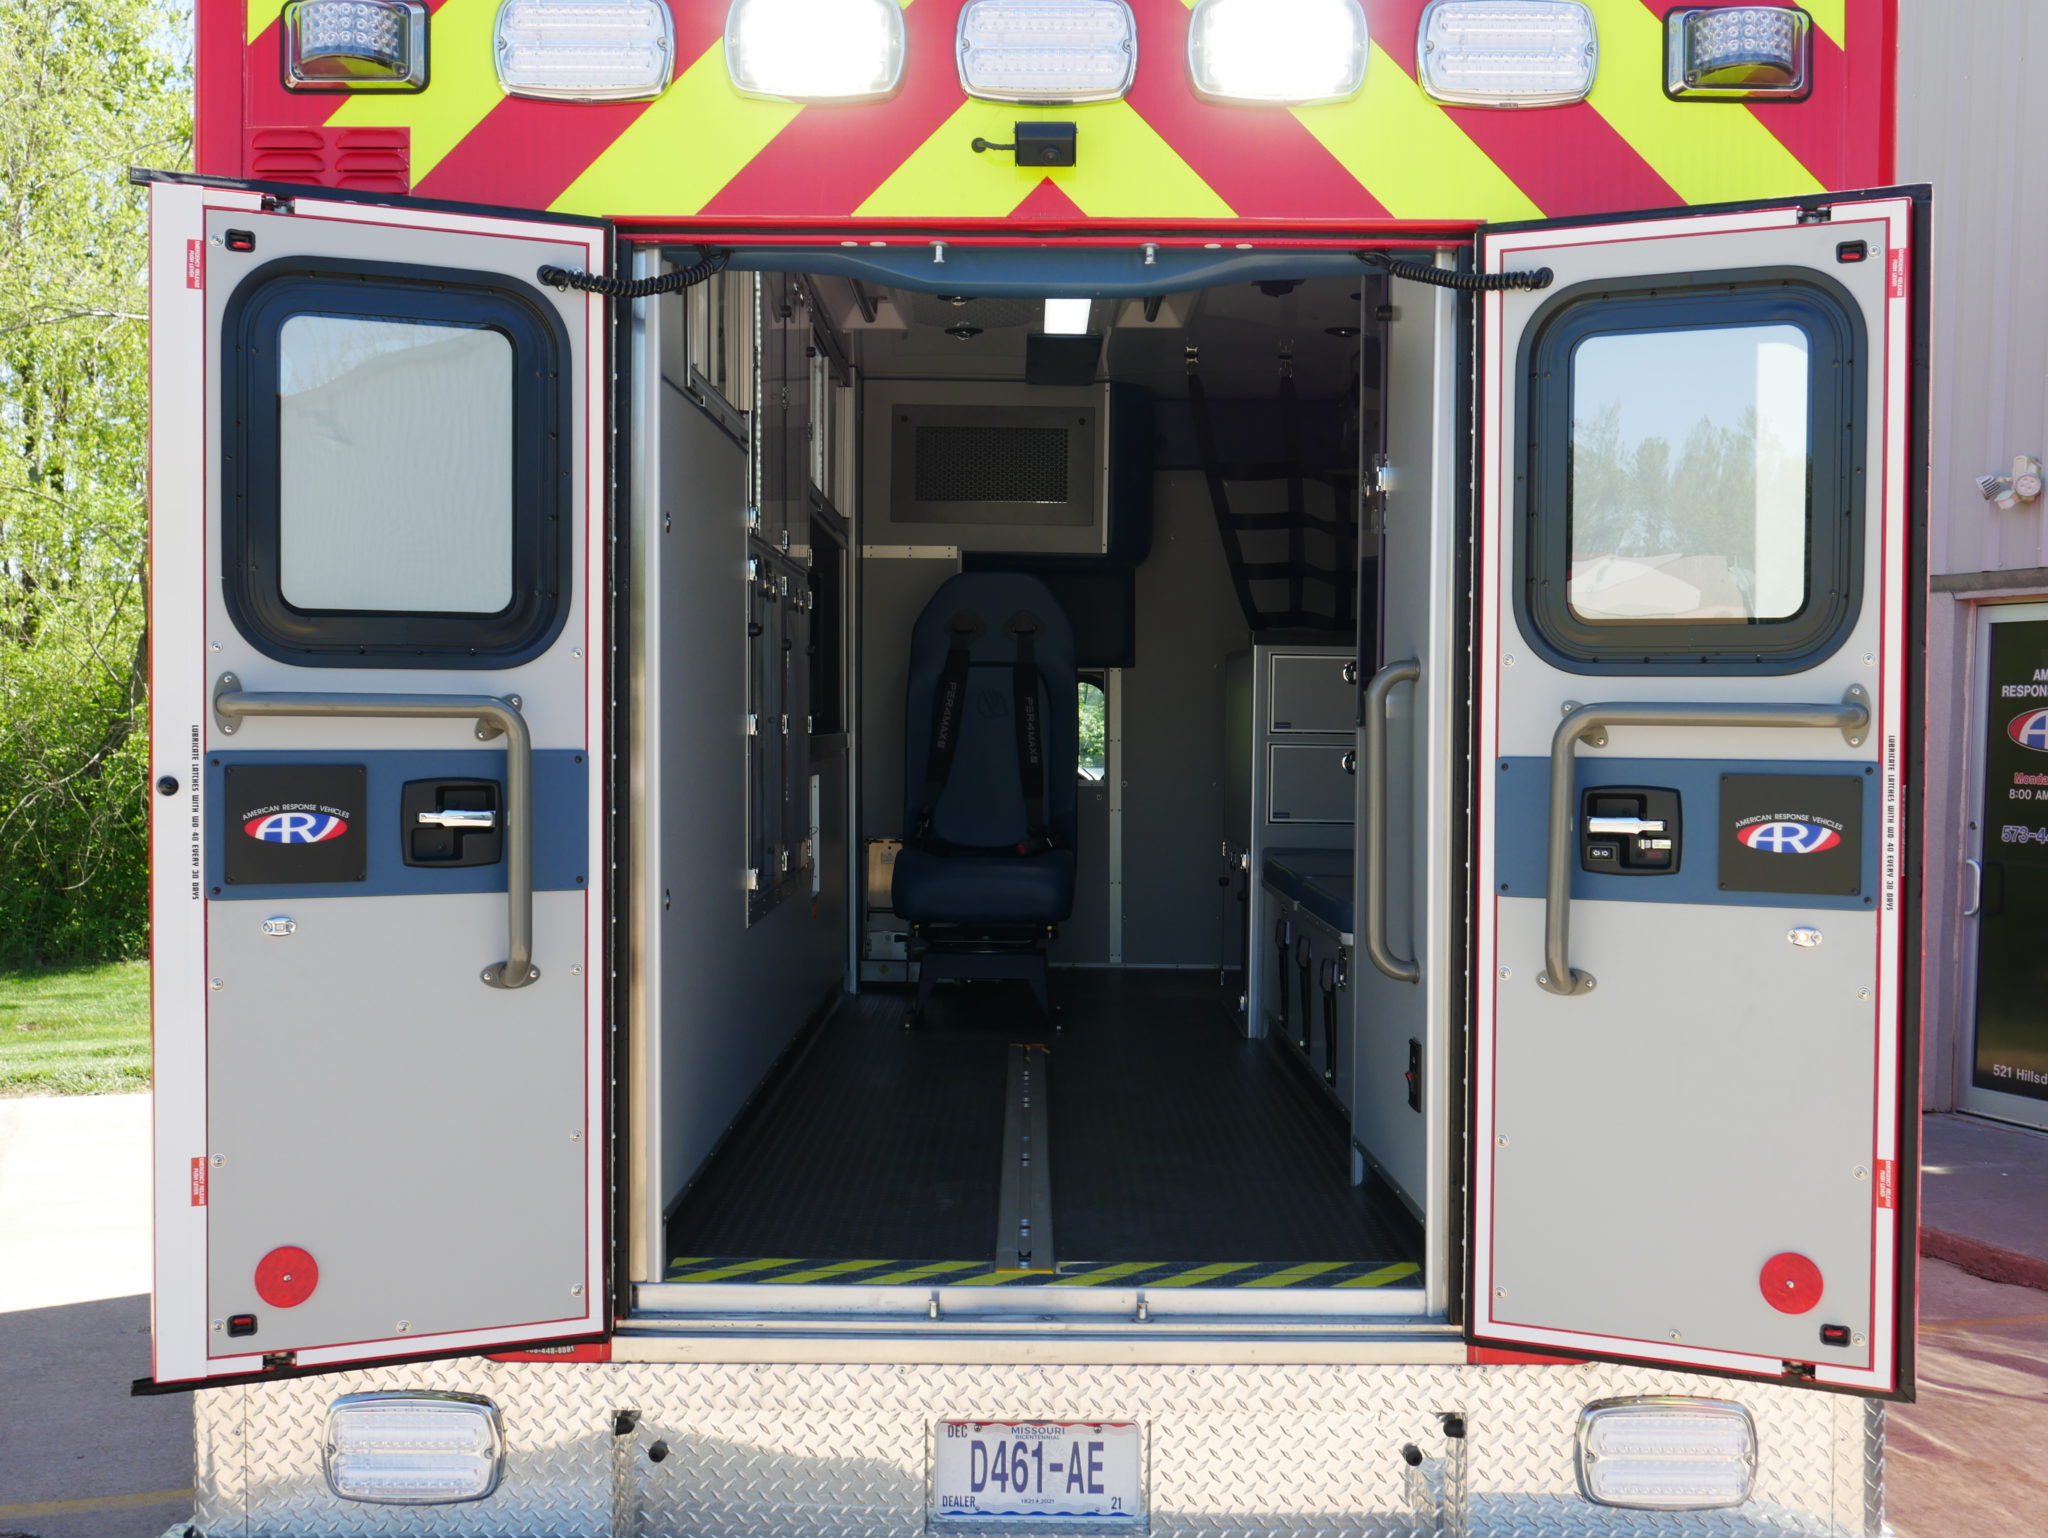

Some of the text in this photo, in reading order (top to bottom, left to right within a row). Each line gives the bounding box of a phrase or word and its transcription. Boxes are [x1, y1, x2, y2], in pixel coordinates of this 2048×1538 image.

[2001, 685, 2048, 698] RESPON
[1888, 735, 1896, 770] LUBRICATE
[1888, 774, 1896, 802] LATCHES
[2009, 788, 2033, 801] 8:00
[242, 803, 350, 820] AMERICAN RESPONSE VEHICLES
[1887, 805, 1895, 823] WITH
[255, 812, 340, 844] ARV
[1735, 813, 1844, 831] AMERICAN RESPONSE VEHICLES
[1747, 822, 1833, 854] ARV
[2001, 825, 2048, 844] 573-4
[192, 870, 199, 880] 30
[1886, 855, 1894, 877] EVERY
[192, 882, 200, 900] DAYS
[1886, 893, 1894, 911] DAYS
[1993, 1064, 2048, 1085] 521 Hillsd
[947, 1425, 969, 1438] DEC
[1011, 1427, 1065, 1436] MISSOURI
[971, 1440, 1104, 1494] D461-AE
[942, 1496, 976, 1508] DEALER
[1110, 1497, 1122, 1511] 21
